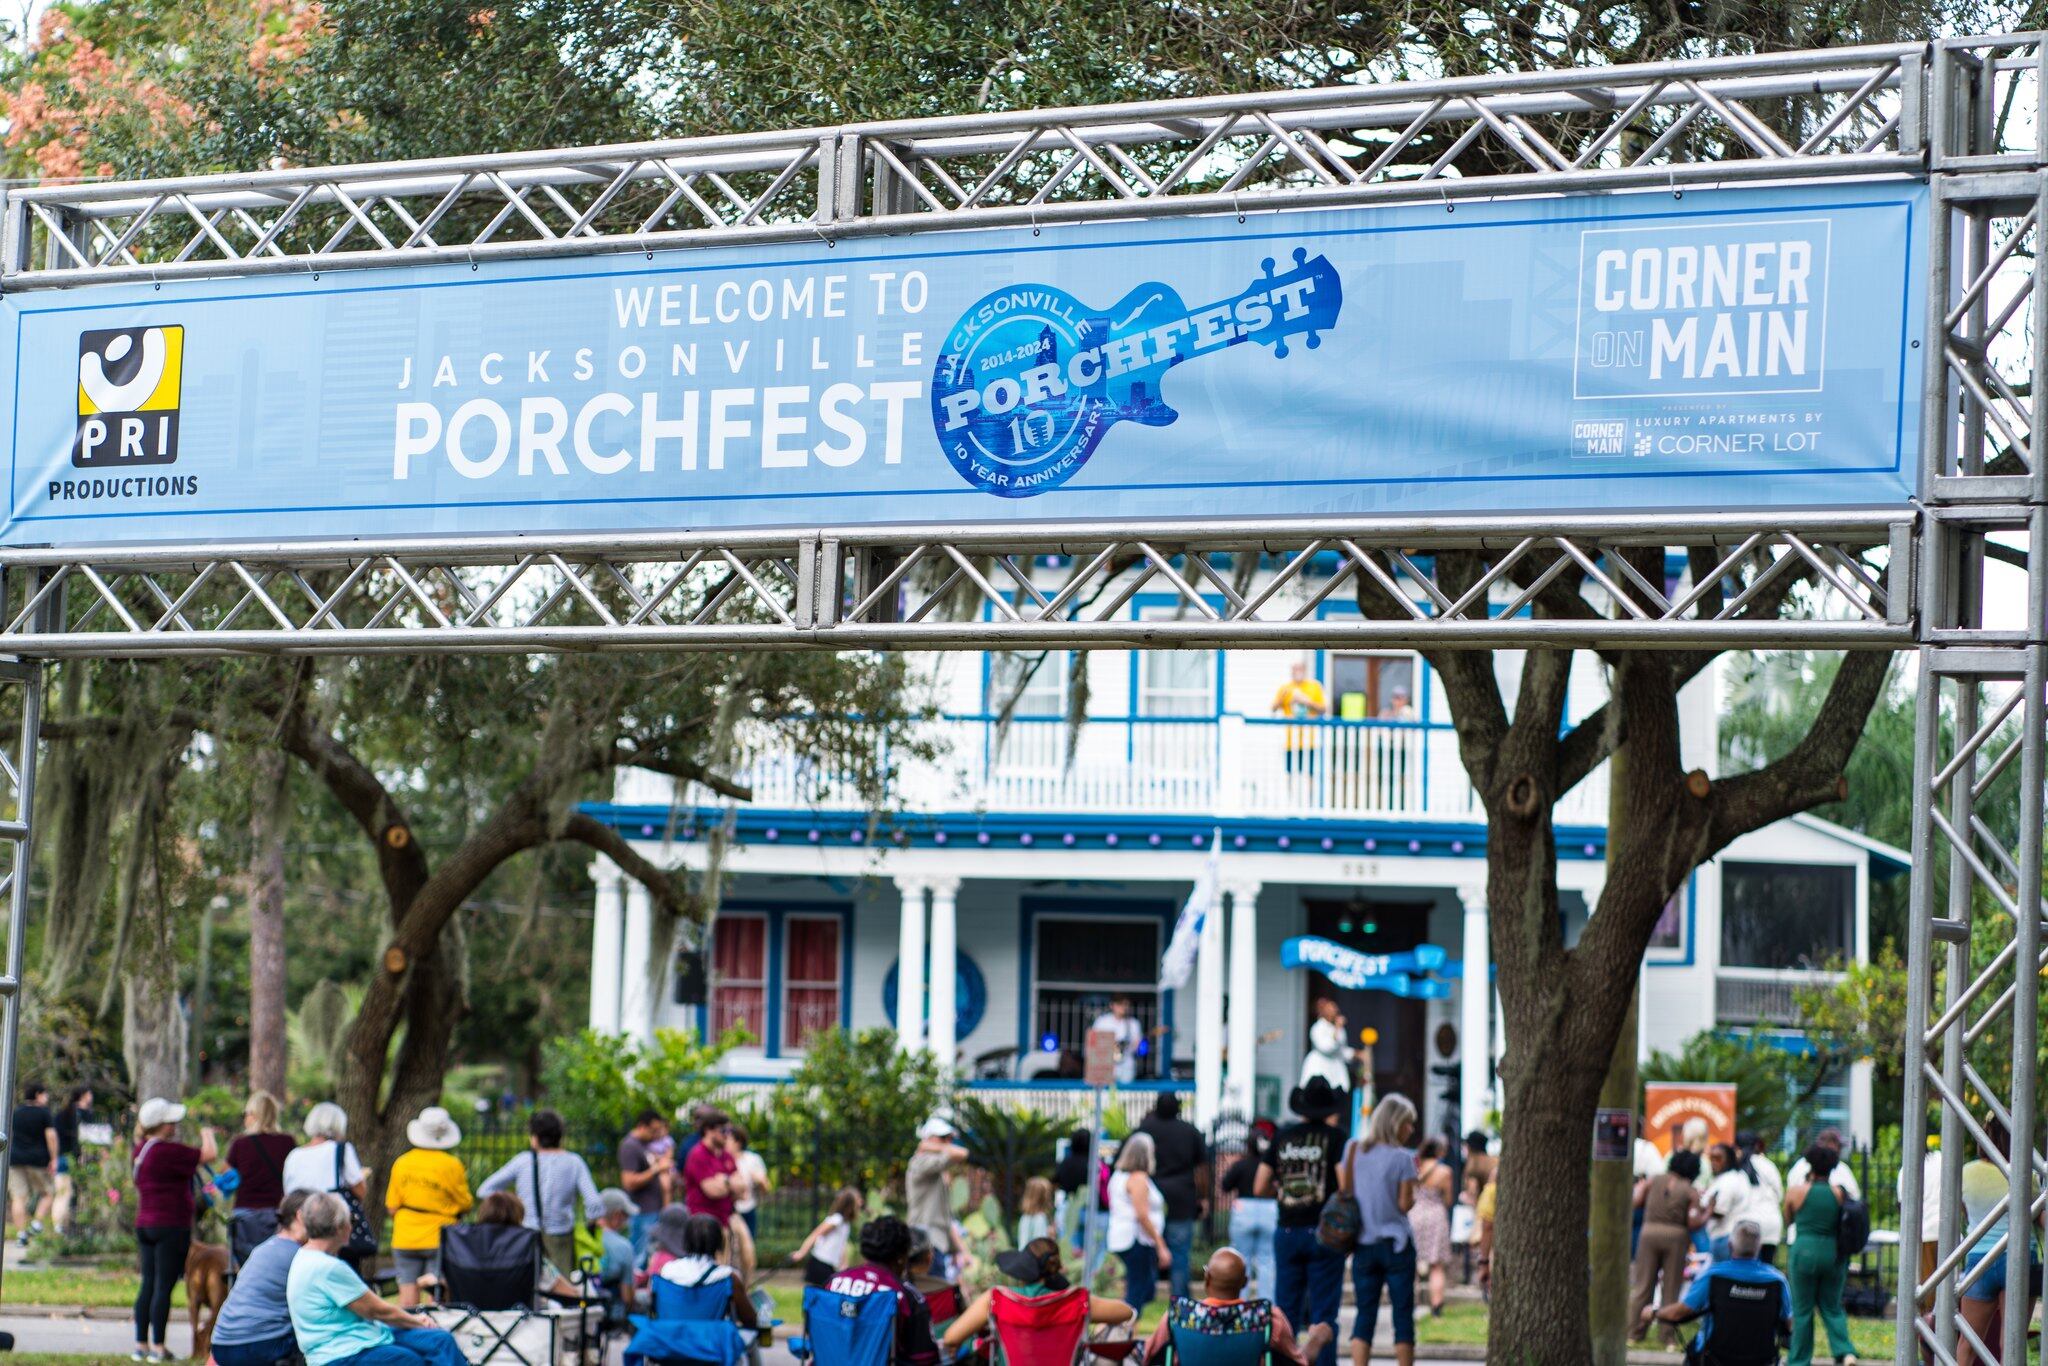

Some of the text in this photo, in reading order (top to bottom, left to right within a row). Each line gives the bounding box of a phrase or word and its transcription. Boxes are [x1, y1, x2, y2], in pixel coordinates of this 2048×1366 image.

[614, 271, 928, 328] WELCOME TO
[1594, 240, 1812, 312] CORNER
[398, 332, 923, 389] JACKSONVILLE
[940, 277, 1316, 432] PORCHFEST
[942, 291, 1093, 386] JACKSONVILLE
[980, 338, 1051, 371] 2014-2024
[1591, 310, 1809, 380] ON MAIN
[82, 416, 169, 459] PRI
[393, 381, 923, 479] PORCHFEST
[953, 398, 1104, 488] 10 YEAR ANNIVERSARY
[1575, 422, 1624, 439] CORNER
[1635, 412, 1823, 427] LUXURY APARTMENTS BY
[1658, 431, 1821, 455] CORNER LOT
[1587, 438, 1623, 455] MAIN
[49, 475, 199, 500] PRODUCTIONS
[1279, 1142, 1322, 1163] Jeep
